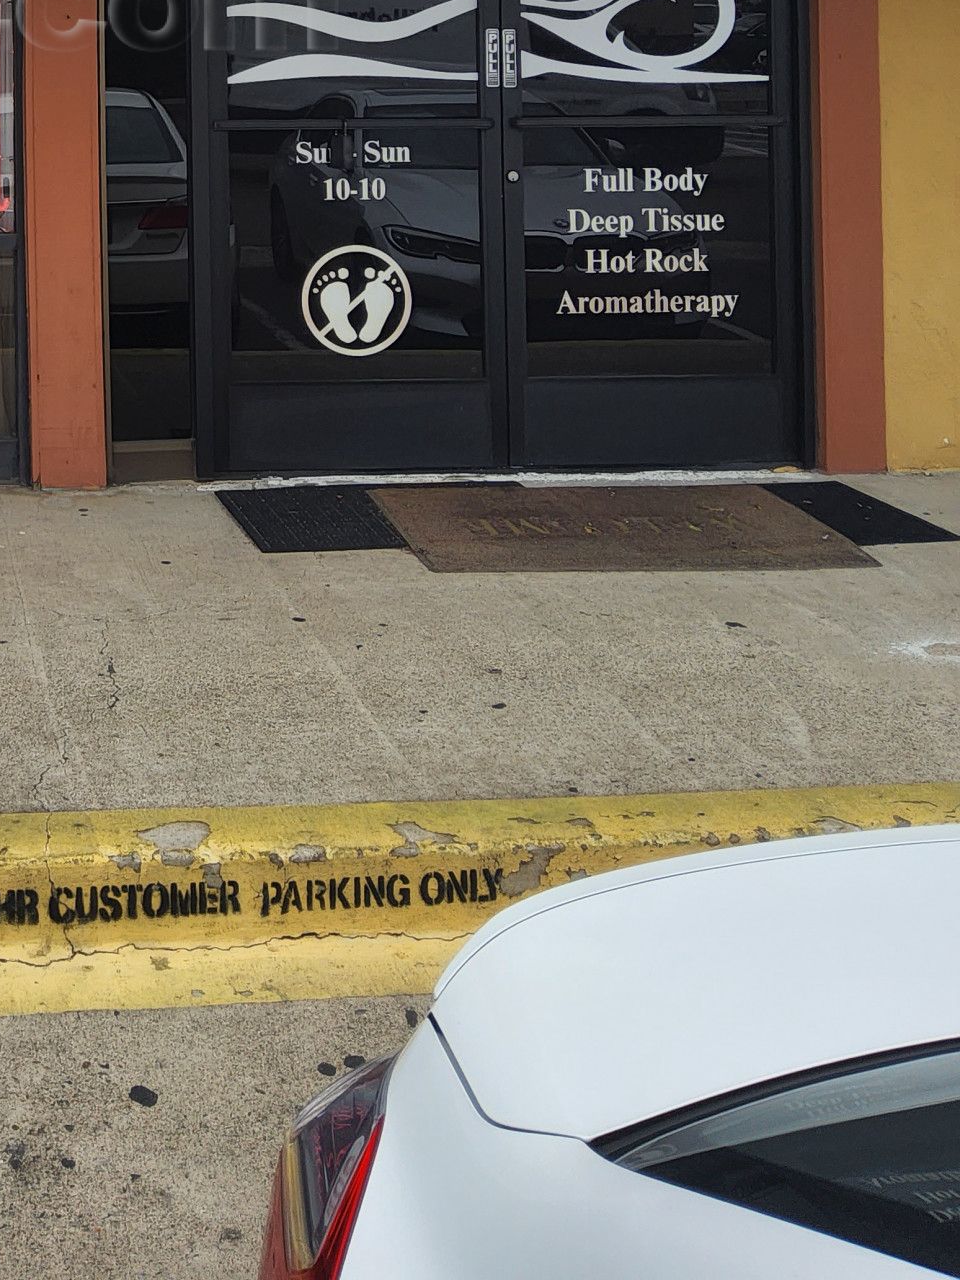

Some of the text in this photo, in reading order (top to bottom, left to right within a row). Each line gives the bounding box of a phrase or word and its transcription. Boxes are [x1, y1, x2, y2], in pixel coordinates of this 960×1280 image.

[489, 34, 497, 73] PULL
[506, 34, 514, 73] PULL
[296, 141, 331, 163] Su
[364, 140, 411, 163] Sun
[323, 177, 386, 200] 10-10
[583, 167, 708, 196] Full Body
[567, 208, 725, 238] Deep Tissue
[585, 248, 709, 273] Hot Rock
[556, 289, 739, 317] Aromatherapy
[48, 879, 240, 924] CUSTOMER
[260, 873, 411, 918] PARKING
[419, 868, 503, 906] ONLY
